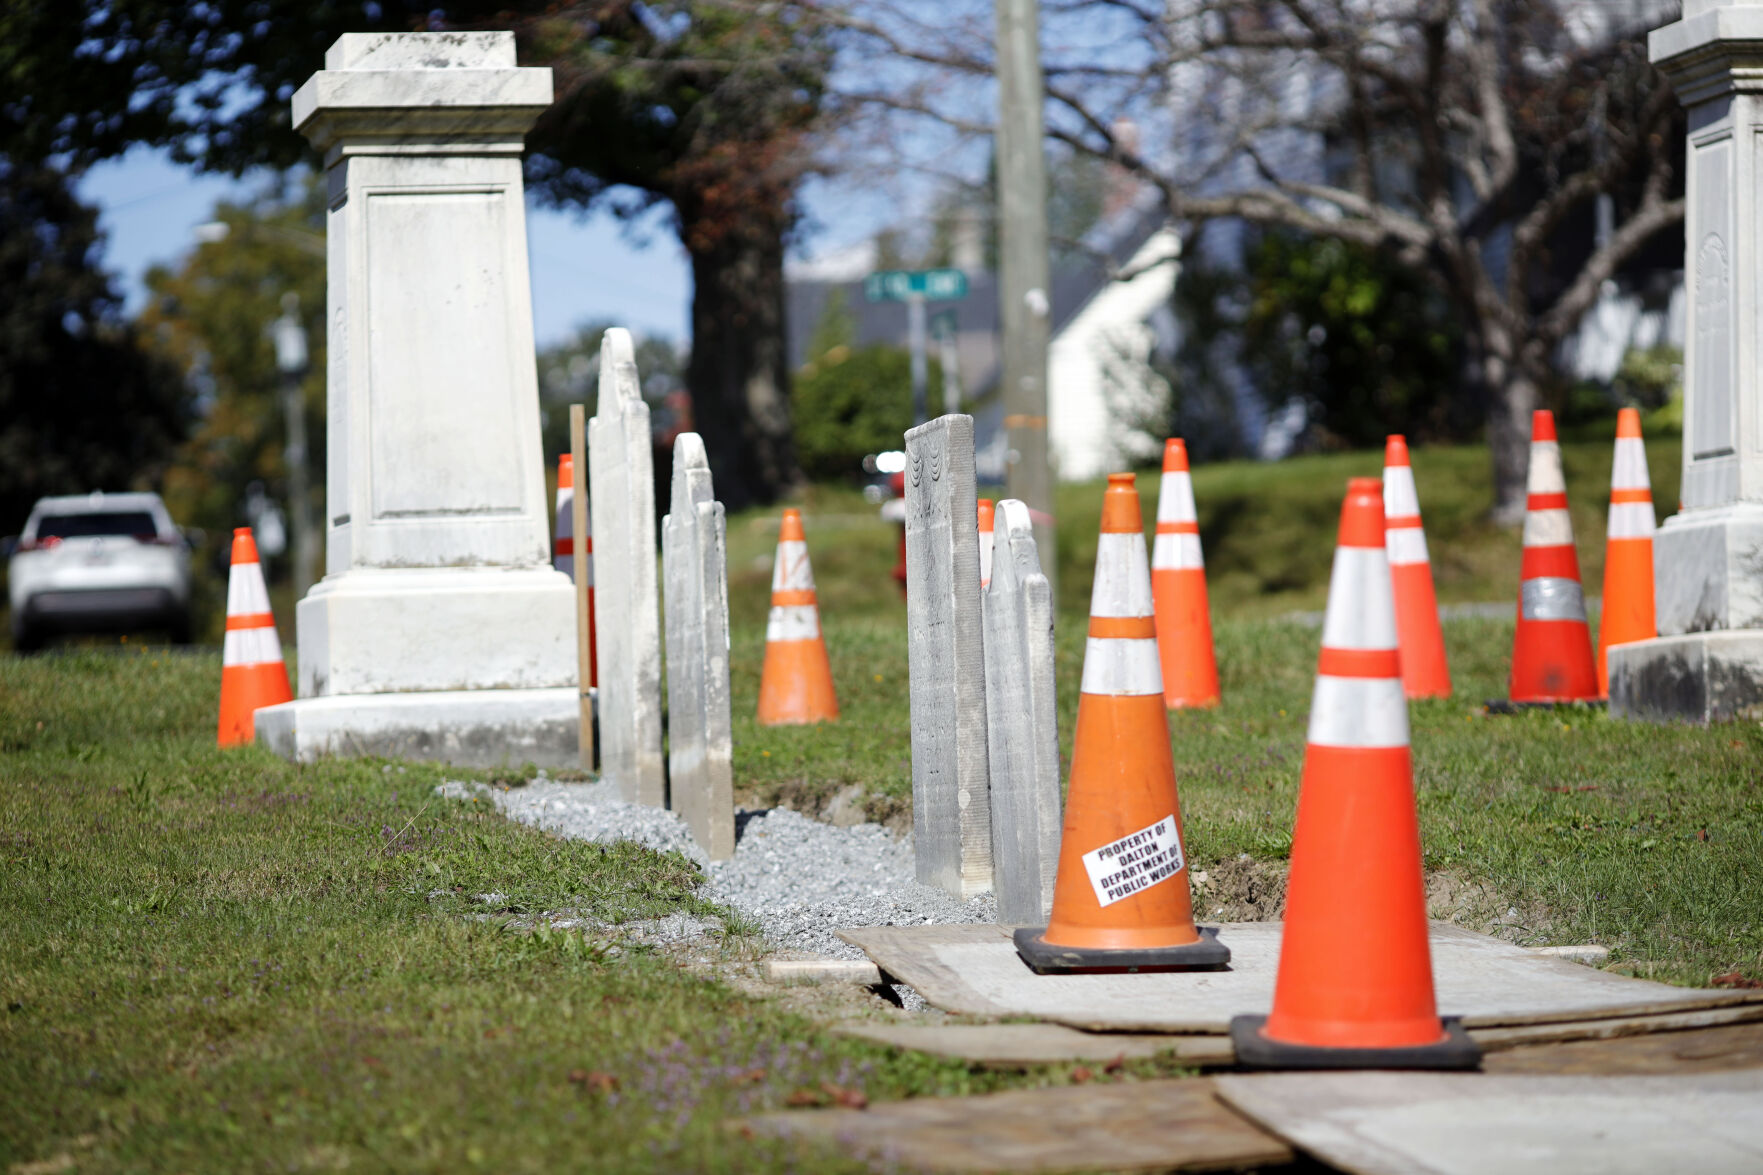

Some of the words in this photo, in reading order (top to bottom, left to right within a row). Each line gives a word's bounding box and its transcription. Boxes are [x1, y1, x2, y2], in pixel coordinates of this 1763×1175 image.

[1098, 829, 1154, 861] PROPERTY
[1155, 823, 1166, 836] OF
[1118, 842, 1158, 866] DALTON
[1100, 852, 1168, 889] DEPARTMENT
[1169, 844, 1178, 857] OF
[1107, 875, 1148, 900] PUBLIC
[1149, 859, 1181, 882] WORKS
